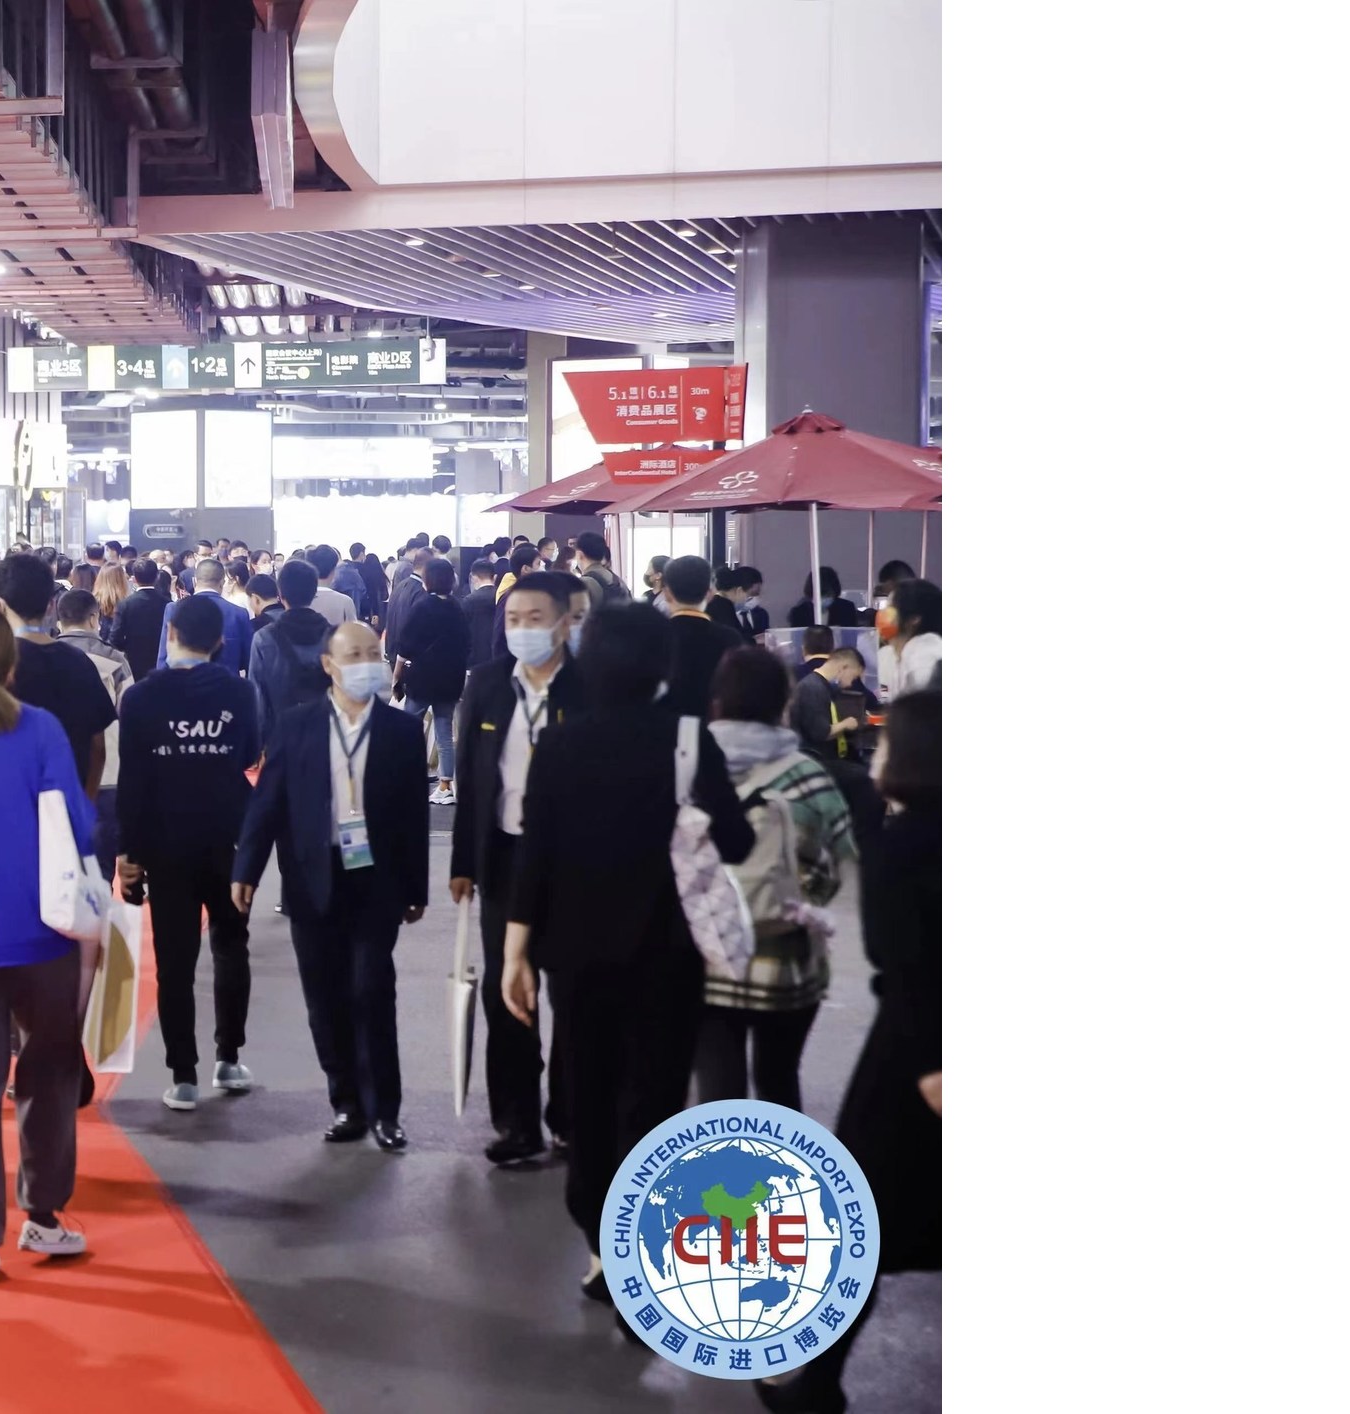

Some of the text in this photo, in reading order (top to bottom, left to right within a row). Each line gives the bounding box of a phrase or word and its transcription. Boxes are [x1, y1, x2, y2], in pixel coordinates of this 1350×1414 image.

[367, 351, 412, 364] 商业D区
[608, 386, 627, 400] 5.1
[647, 386, 666, 399] 6.1
[690, 387, 710, 396] 30m
[616, 404, 678, 417] 消费品展区
[640, 460, 676, 469] 洲际酒店
[684, 462, 703, 471] 300
